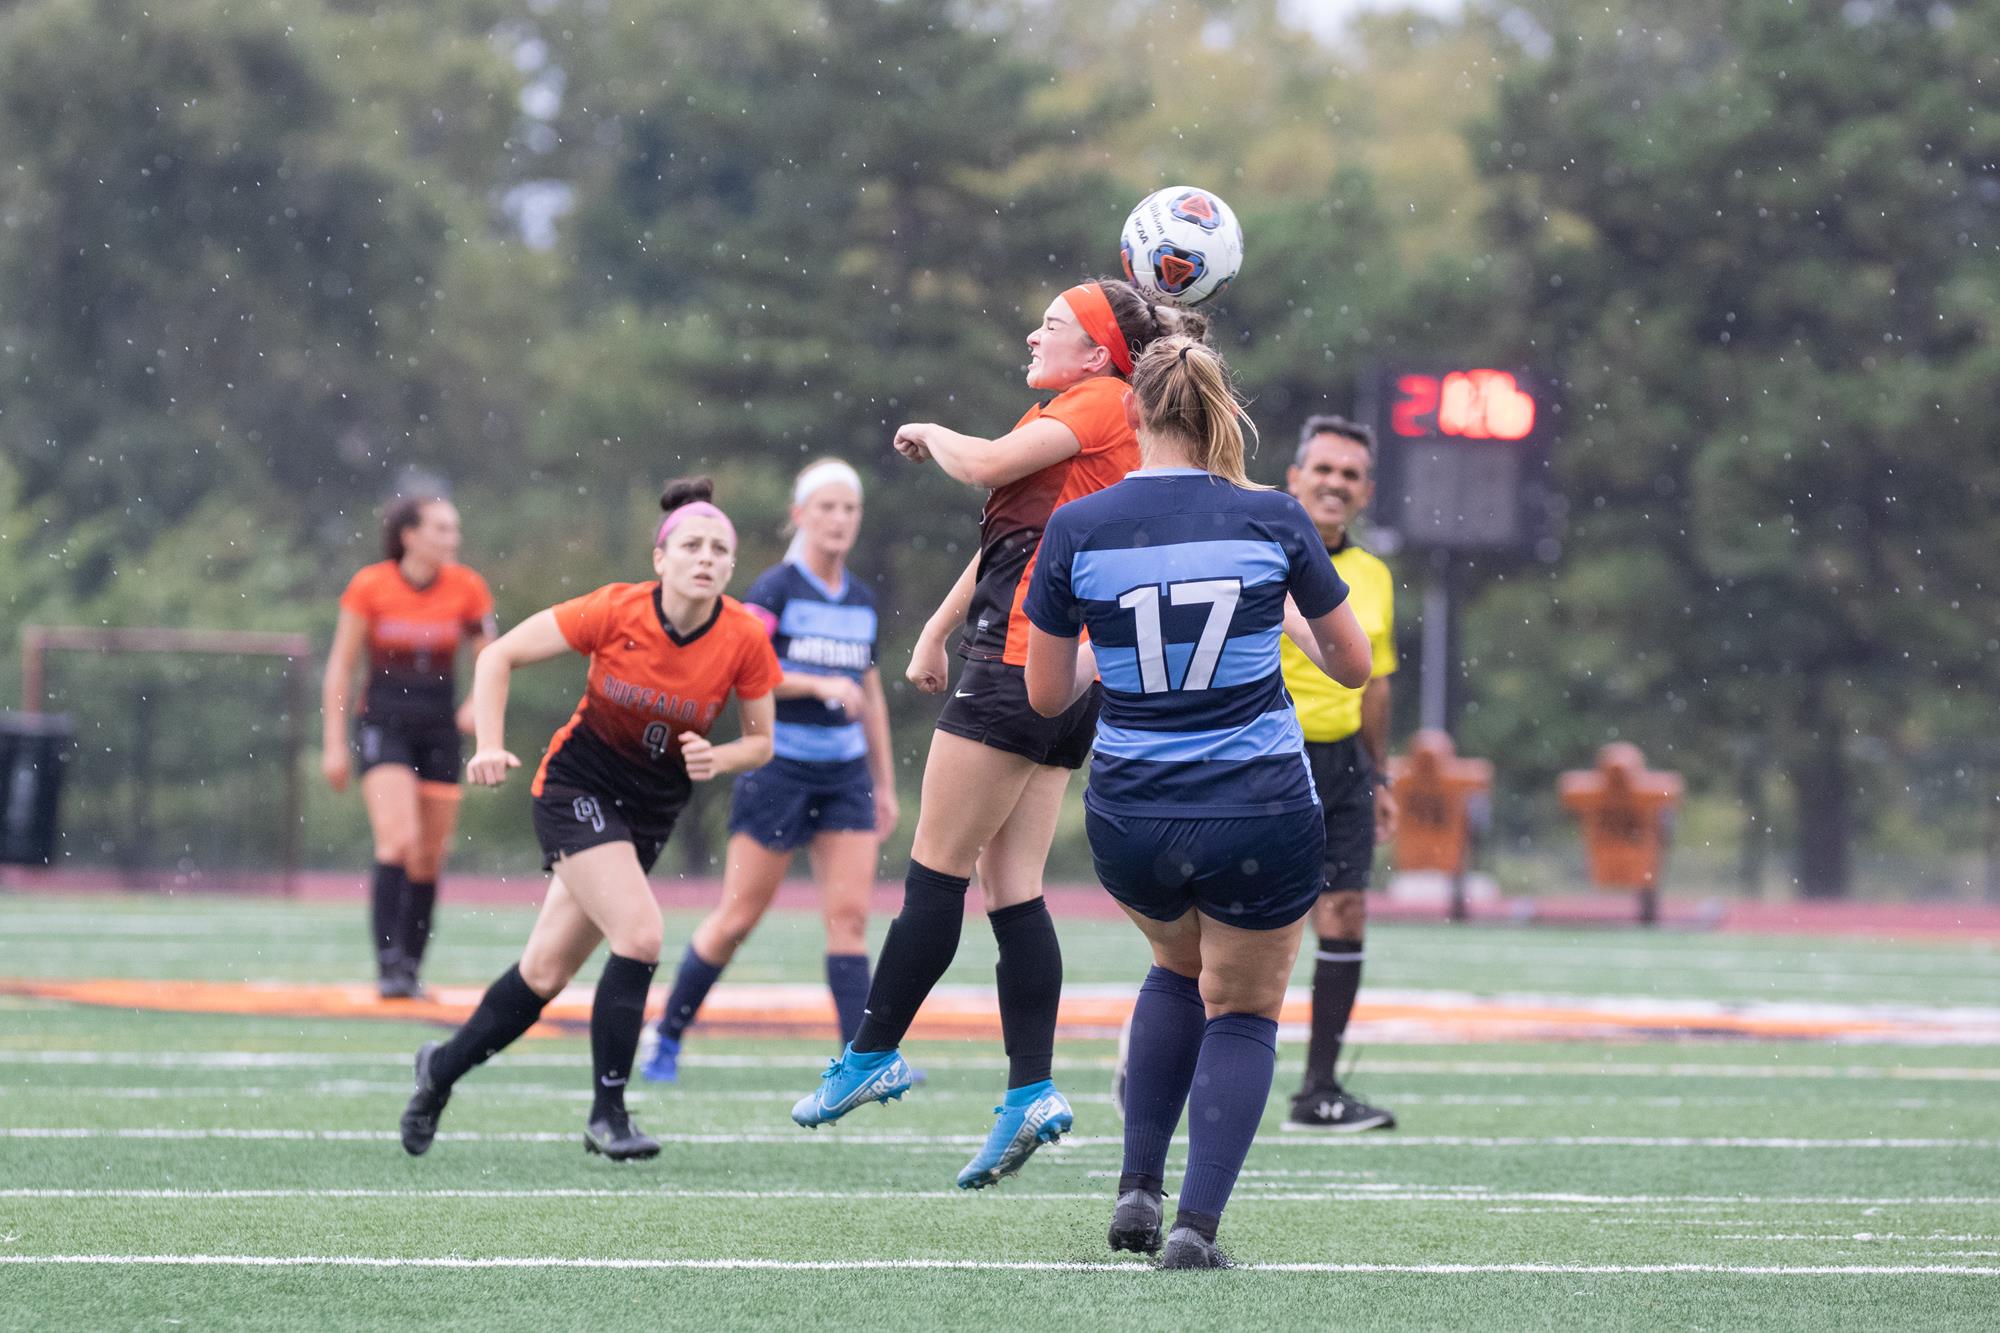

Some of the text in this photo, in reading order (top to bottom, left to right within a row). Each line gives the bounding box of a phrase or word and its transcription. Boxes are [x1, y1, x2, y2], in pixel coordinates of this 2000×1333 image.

[1118, 579, 1242, 694] 17
[603, 673, 698, 722] BUFFALO
[642, 720, 673, 760] 9
[573, 797, 606, 833] 9
